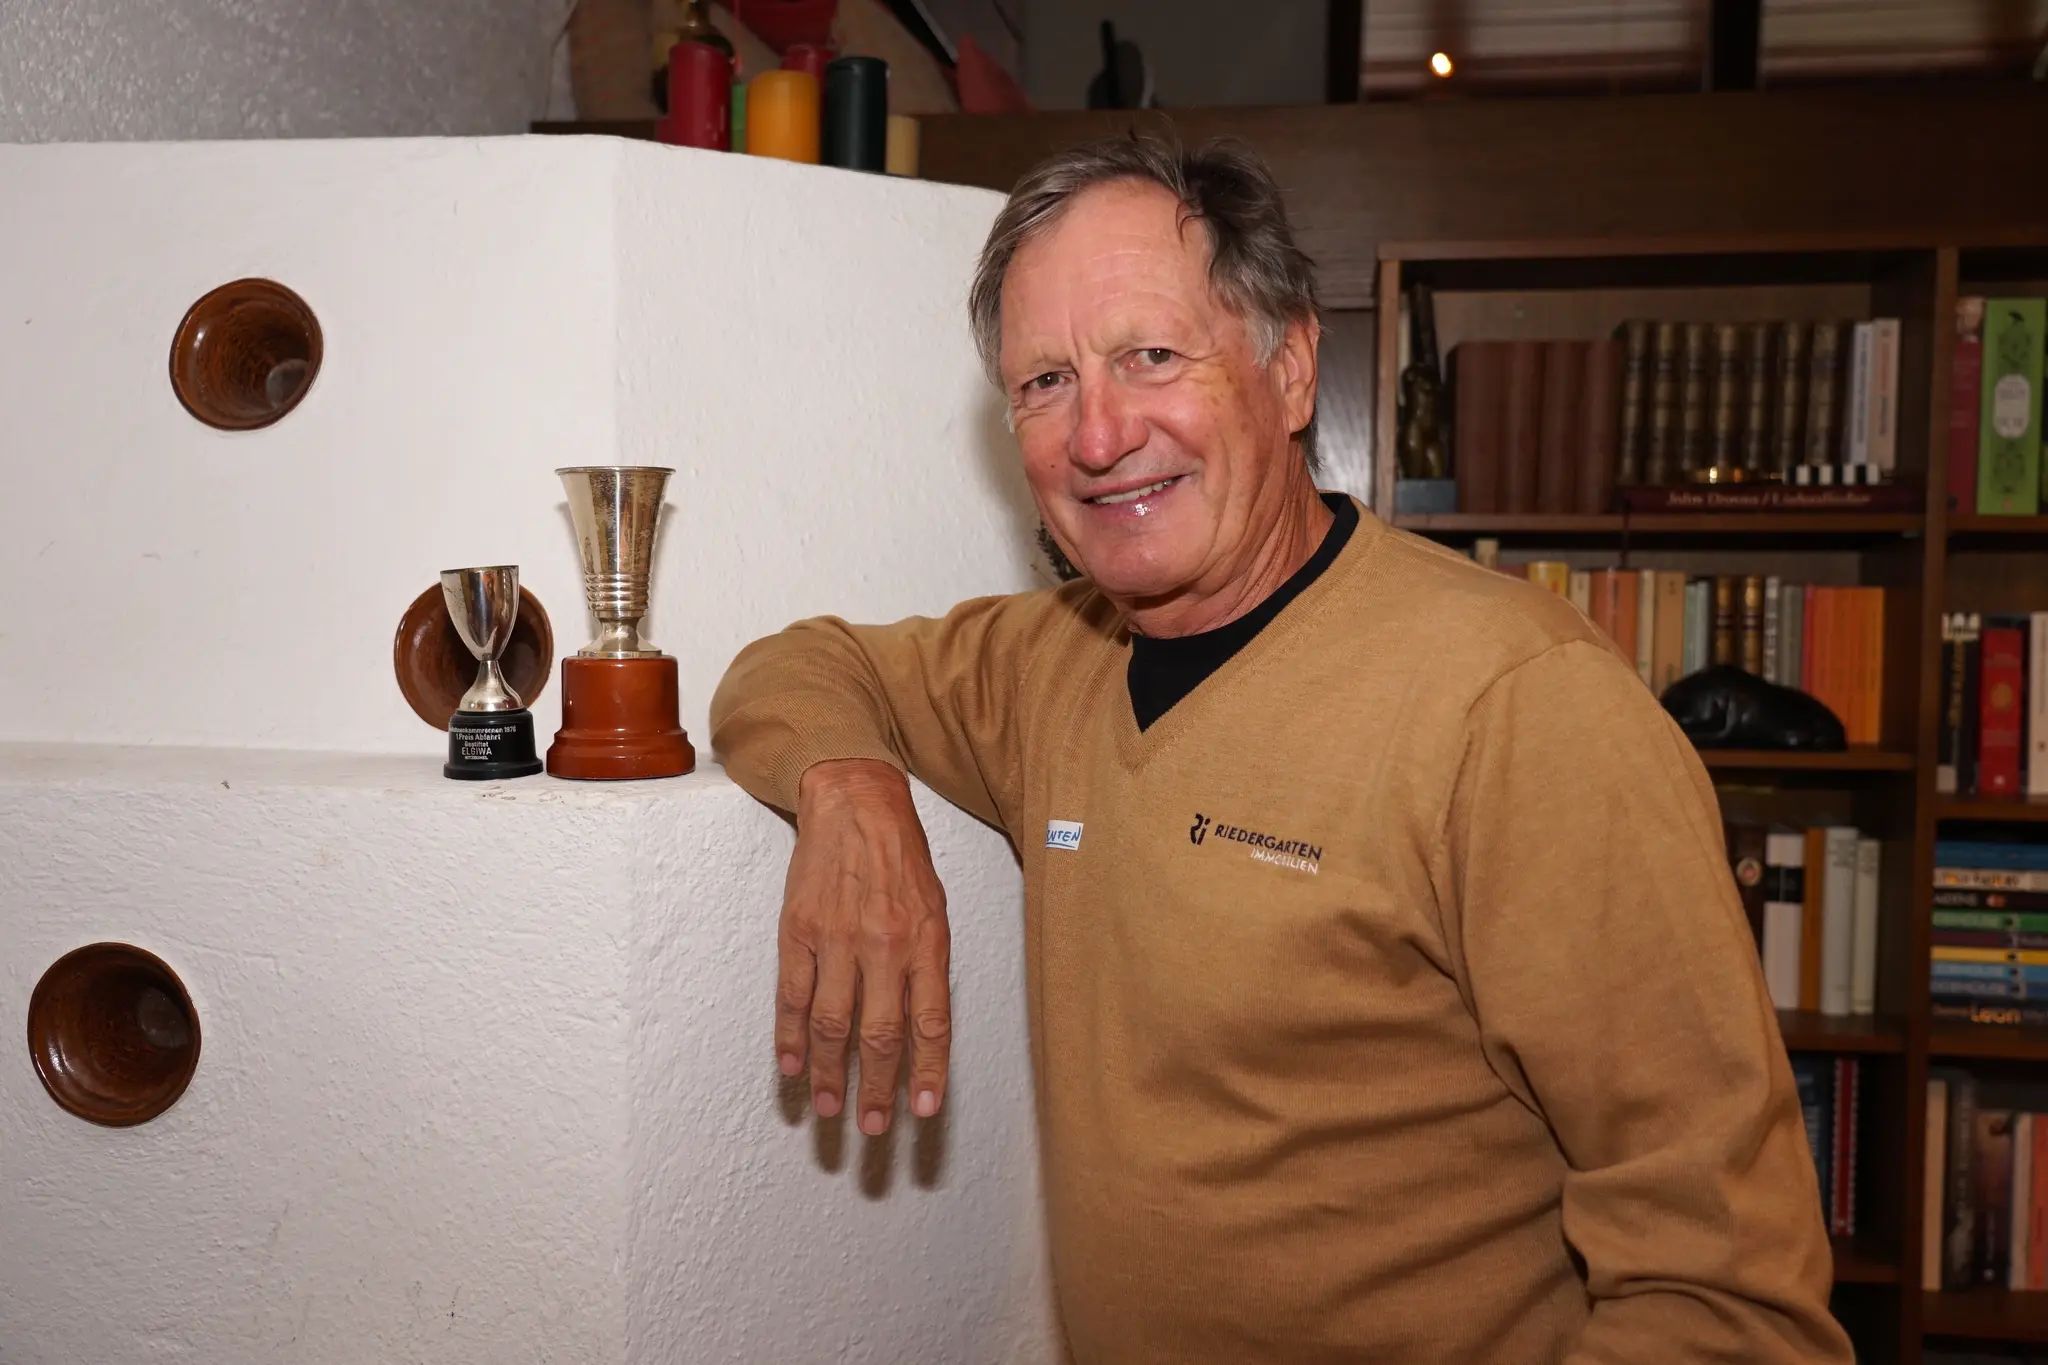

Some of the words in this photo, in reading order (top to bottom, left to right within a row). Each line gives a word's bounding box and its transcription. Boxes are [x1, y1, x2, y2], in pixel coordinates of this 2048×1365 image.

[461, 747, 492, 755] ELGIWA
[1214, 823, 1322, 861] RIEDERGARTEN
[1250, 847, 1319, 875] IMMOBILIEN
